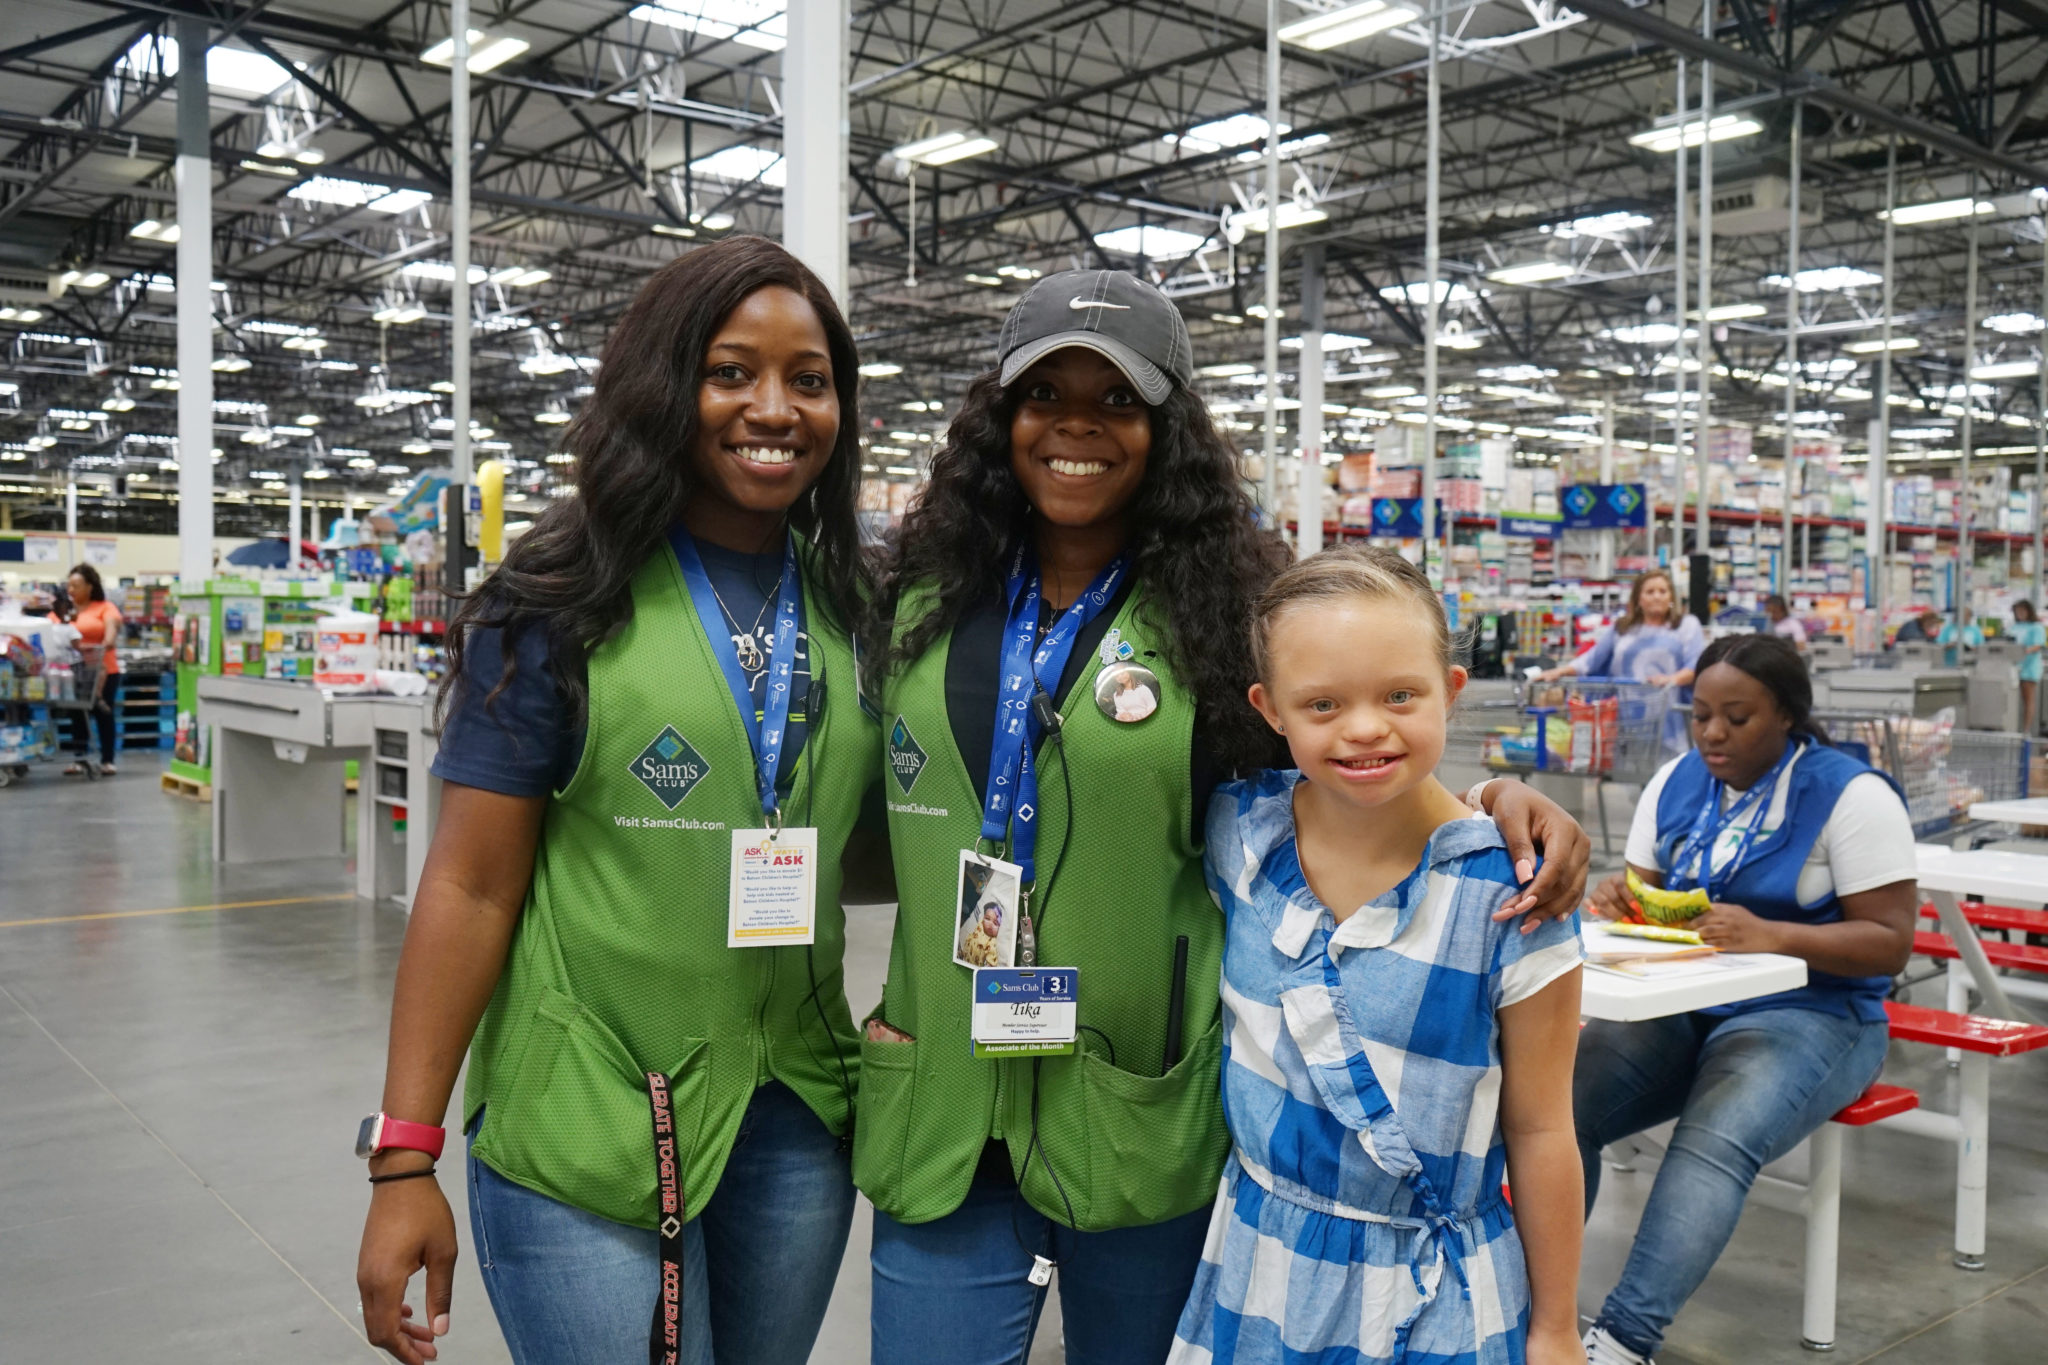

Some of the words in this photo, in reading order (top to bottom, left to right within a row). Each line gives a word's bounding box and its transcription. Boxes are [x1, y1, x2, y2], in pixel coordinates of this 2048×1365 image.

[890, 744, 920, 768] Sam's
[642, 757, 698, 780] Sam's
[896, 766, 914, 774] CLUB
[656, 780, 686, 788] CLUB
[614, 816, 640, 828] Visit
[642, 817, 725, 830] SamsClub.com
[772, 855, 804, 866] ASK
[1022, 983, 1039, 992] Club
[1050, 976, 1061, 992] 3
[1010, 1001, 1041, 1019] Tika
[985, 1043, 1020, 1052] Associate
[1041, 1042, 1065, 1050] Month
[658, 1136, 678, 1214] TOGETHER
[663, 1260, 679, 1347] ACCELERATE
